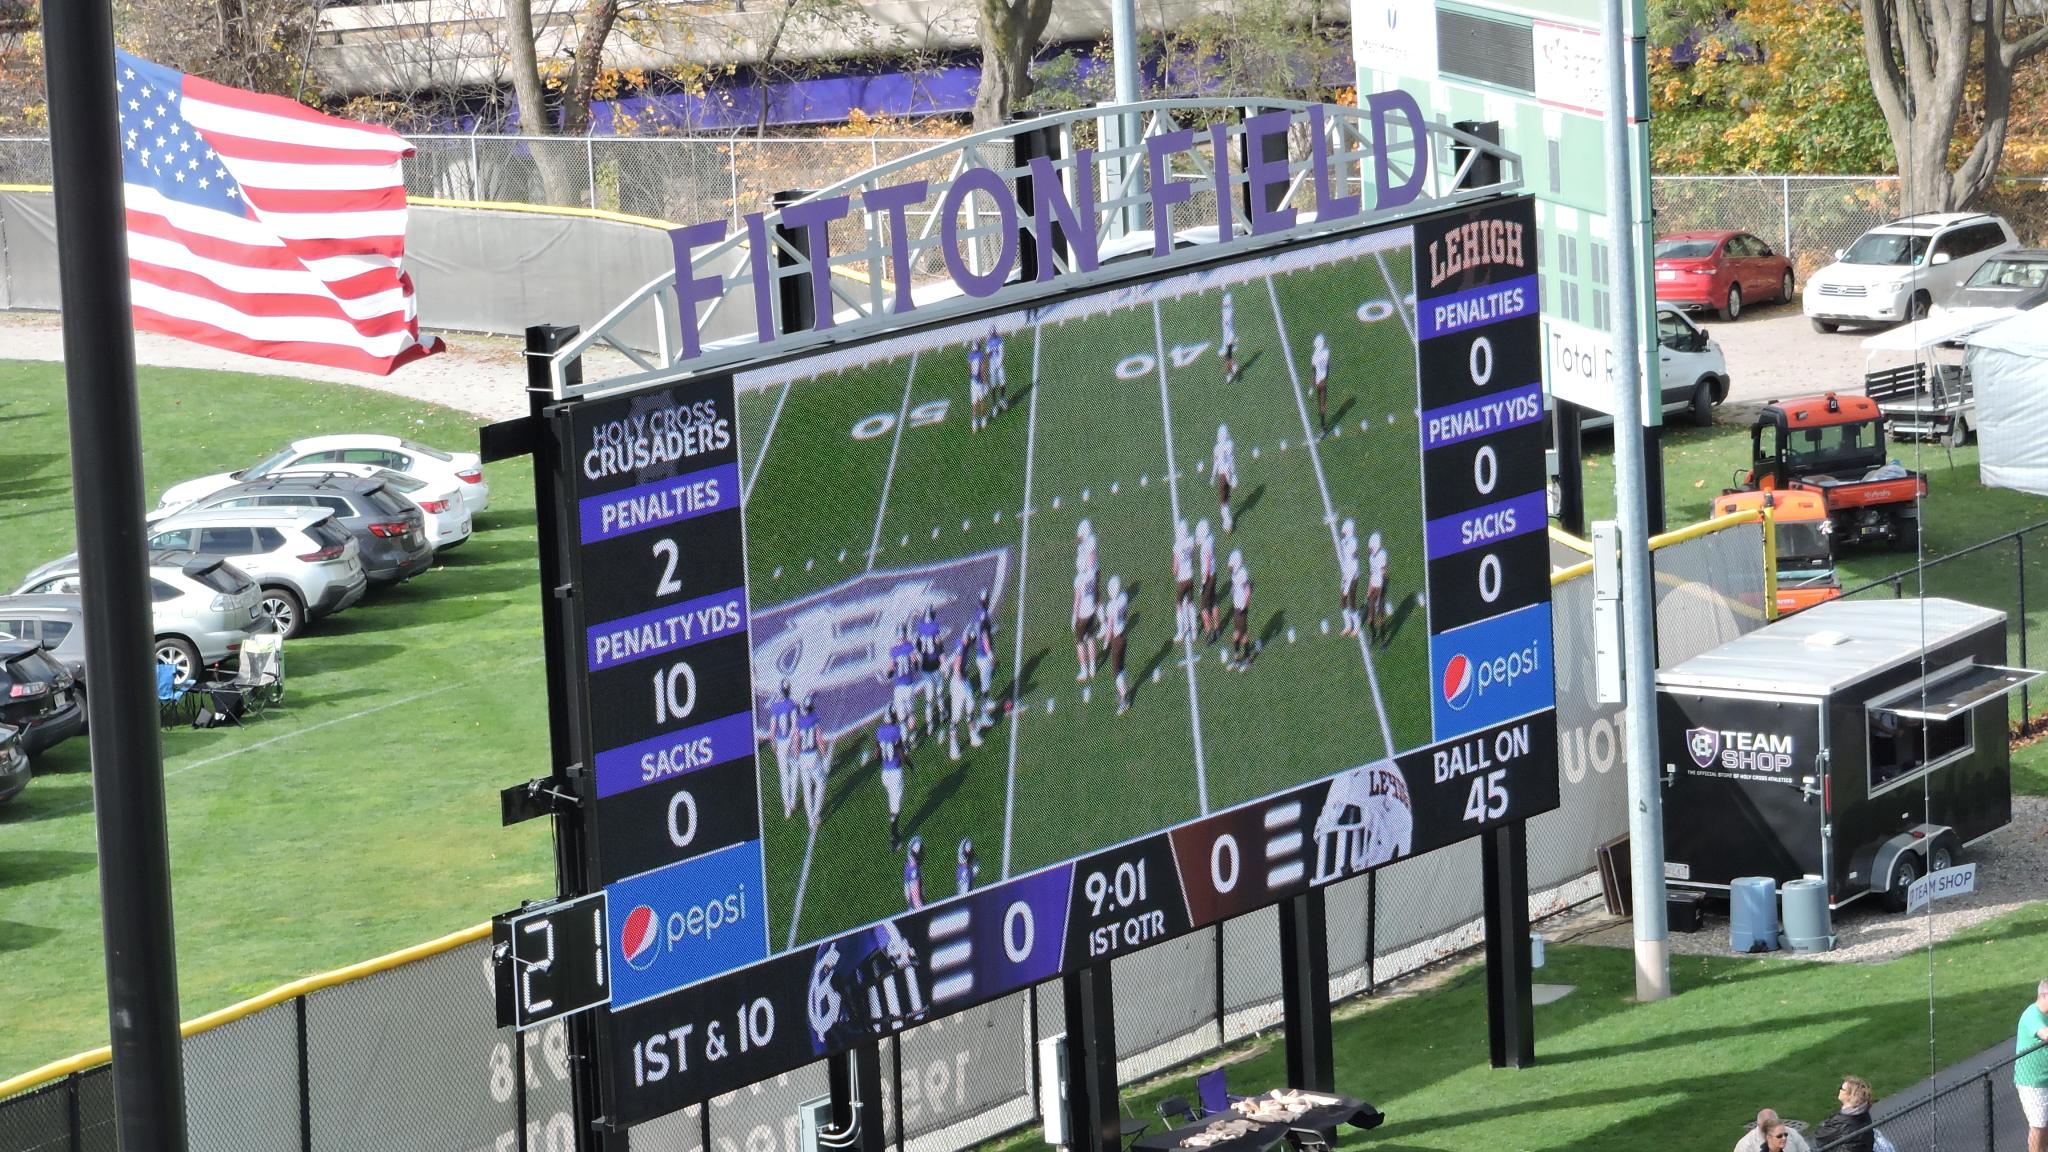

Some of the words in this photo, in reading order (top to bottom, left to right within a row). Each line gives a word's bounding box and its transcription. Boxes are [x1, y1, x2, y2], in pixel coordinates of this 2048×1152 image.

[668, 147, 1099, 360] FITTON
[1146, 89, 1428, 257] FIELD
[1429, 219, 1524, 288] LEHIGH
[1435, 287, 1524, 331] PENALTIES
[1469, 336, 1493, 386] 0
[1553, 333, 1597, 381] Total
[592, 413, 647, 449] HOLY
[650, 399, 717, 434] CROSS
[1429, 401, 1503, 443] PENALTY
[1503, 393, 1538, 423] YDS
[583, 418, 730, 480] CRUSADERS
[1474, 445, 1497, 494] 0
[601, 479, 720, 533] PENALTIES
[1461, 508, 1517, 545] SACKS
[652, 538, 682, 597] 2
[1478, 554, 1501, 602] 0
[595, 614, 693, 664] PENALTY
[698, 601, 740, 634] YDS
[653, 661, 697, 724] 10
[1478, 640, 1539, 696] pepsi
[641, 736, 713, 781] SACKS
[1433, 739, 1491, 783] BALL
[1495, 724, 1529, 762] ON
[1720, 731, 1792, 753] TEAM
[1721, 750, 1792, 772] SHOP
[667, 790, 697, 847] 0
[1463, 769, 1509, 824] 45
[1085, 857, 1147, 917] 9:01
[1211, 834, 1240, 893] 0
[1915, 879, 1936, 901] TEAM
[1938, 871, 1972, 891] SHOP
[667, 883, 746, 952] pepsi
[1003, 901, 1034, 963] 0
[1089, 922, 1121, 957] 1ST
[1124, 910, 1165, 945] QTR
[523, 908, 603, 1013] 21
[633, 1024, 693, 1087] 1ST
[705, 1020, 728, 1062] &
[737, 997, 775, 1052] 10
